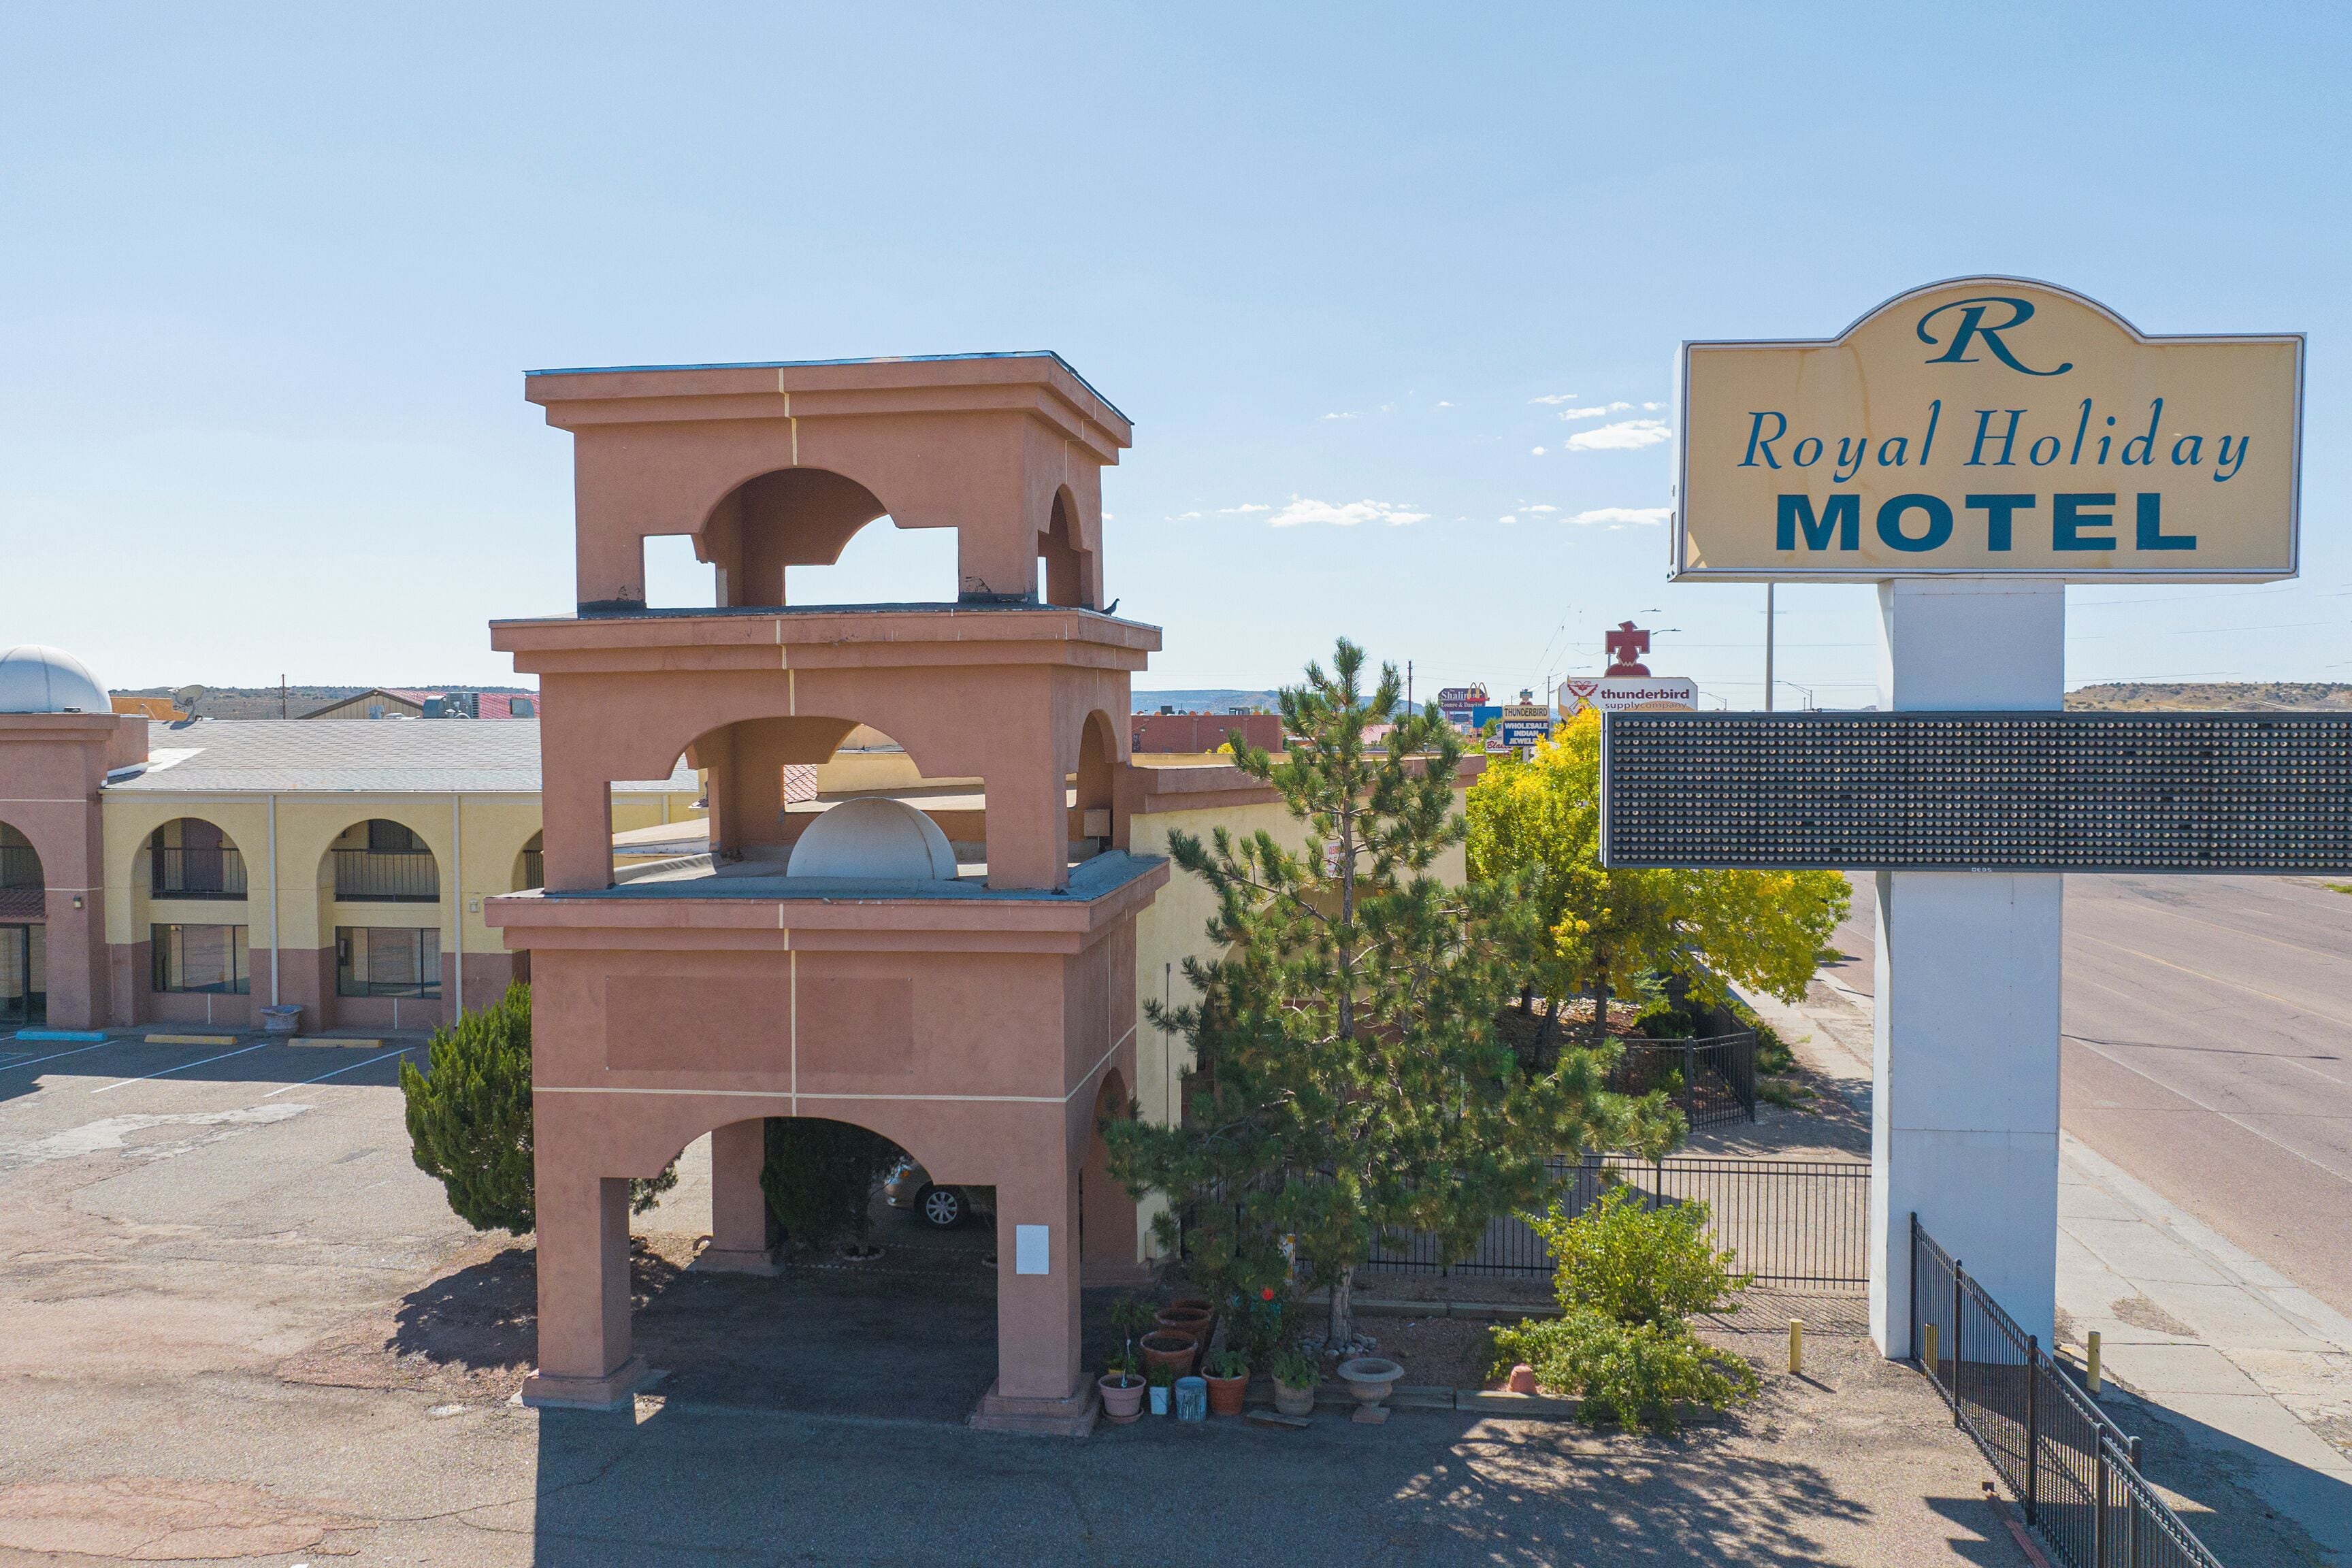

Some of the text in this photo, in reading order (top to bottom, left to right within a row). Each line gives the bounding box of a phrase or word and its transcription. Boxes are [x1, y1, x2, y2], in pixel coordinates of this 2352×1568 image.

[1916, 297, 2074, 376] R
[1737, 397, 2250, 484] Royal Holiday
[1775, 492, 2198, 553] MOTEL
[1504, 708, 1548, 717] THUNDERBIRD
[1601, 689, 1689, 699] thunderbird
